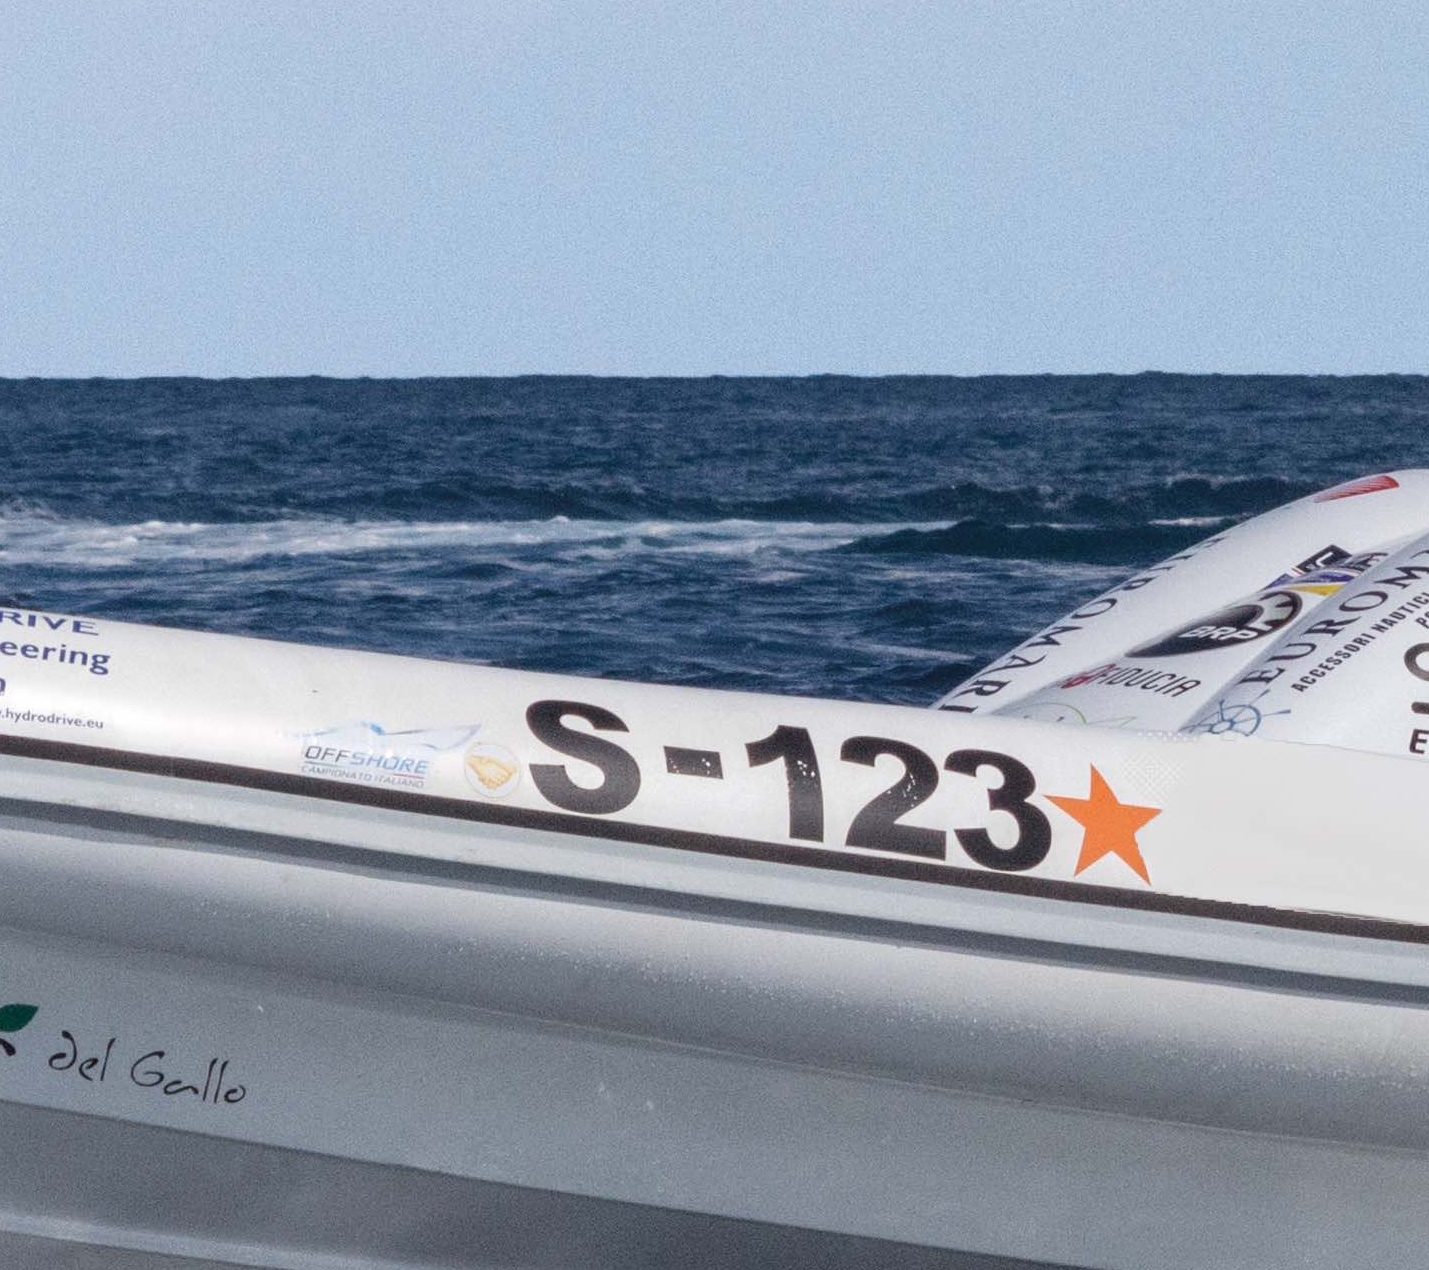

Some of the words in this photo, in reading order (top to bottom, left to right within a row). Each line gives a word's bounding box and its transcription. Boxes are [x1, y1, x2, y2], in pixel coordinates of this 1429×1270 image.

[1178, 626, 1259, 641] BRP
[1290, 632, 1376, 693] ACCESSORI
[305, 745, 429, 774] OFFSHORE
[524, 698, 1054, 873] S-123
[48, 1031, 114, 1082] del
[130, 1051, 246, 1105] Gallo
